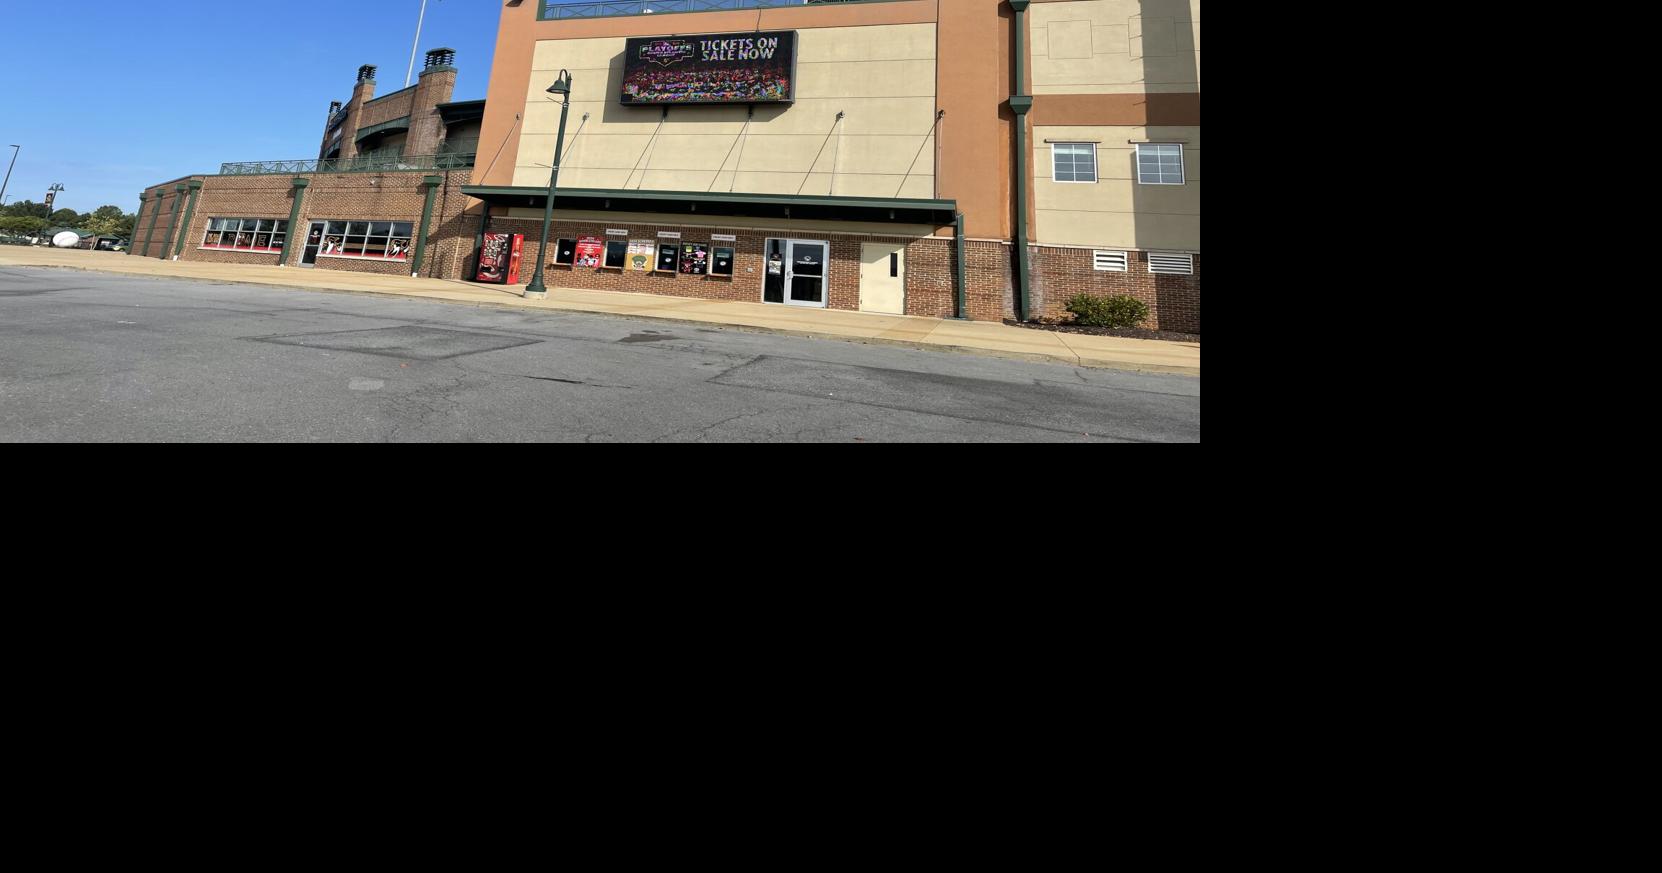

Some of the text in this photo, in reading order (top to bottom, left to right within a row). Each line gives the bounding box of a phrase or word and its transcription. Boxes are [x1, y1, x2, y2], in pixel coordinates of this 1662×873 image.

[700, 37, 778, 51] TICKETS ON
[701, 47, 775, 61] SALE NOW
